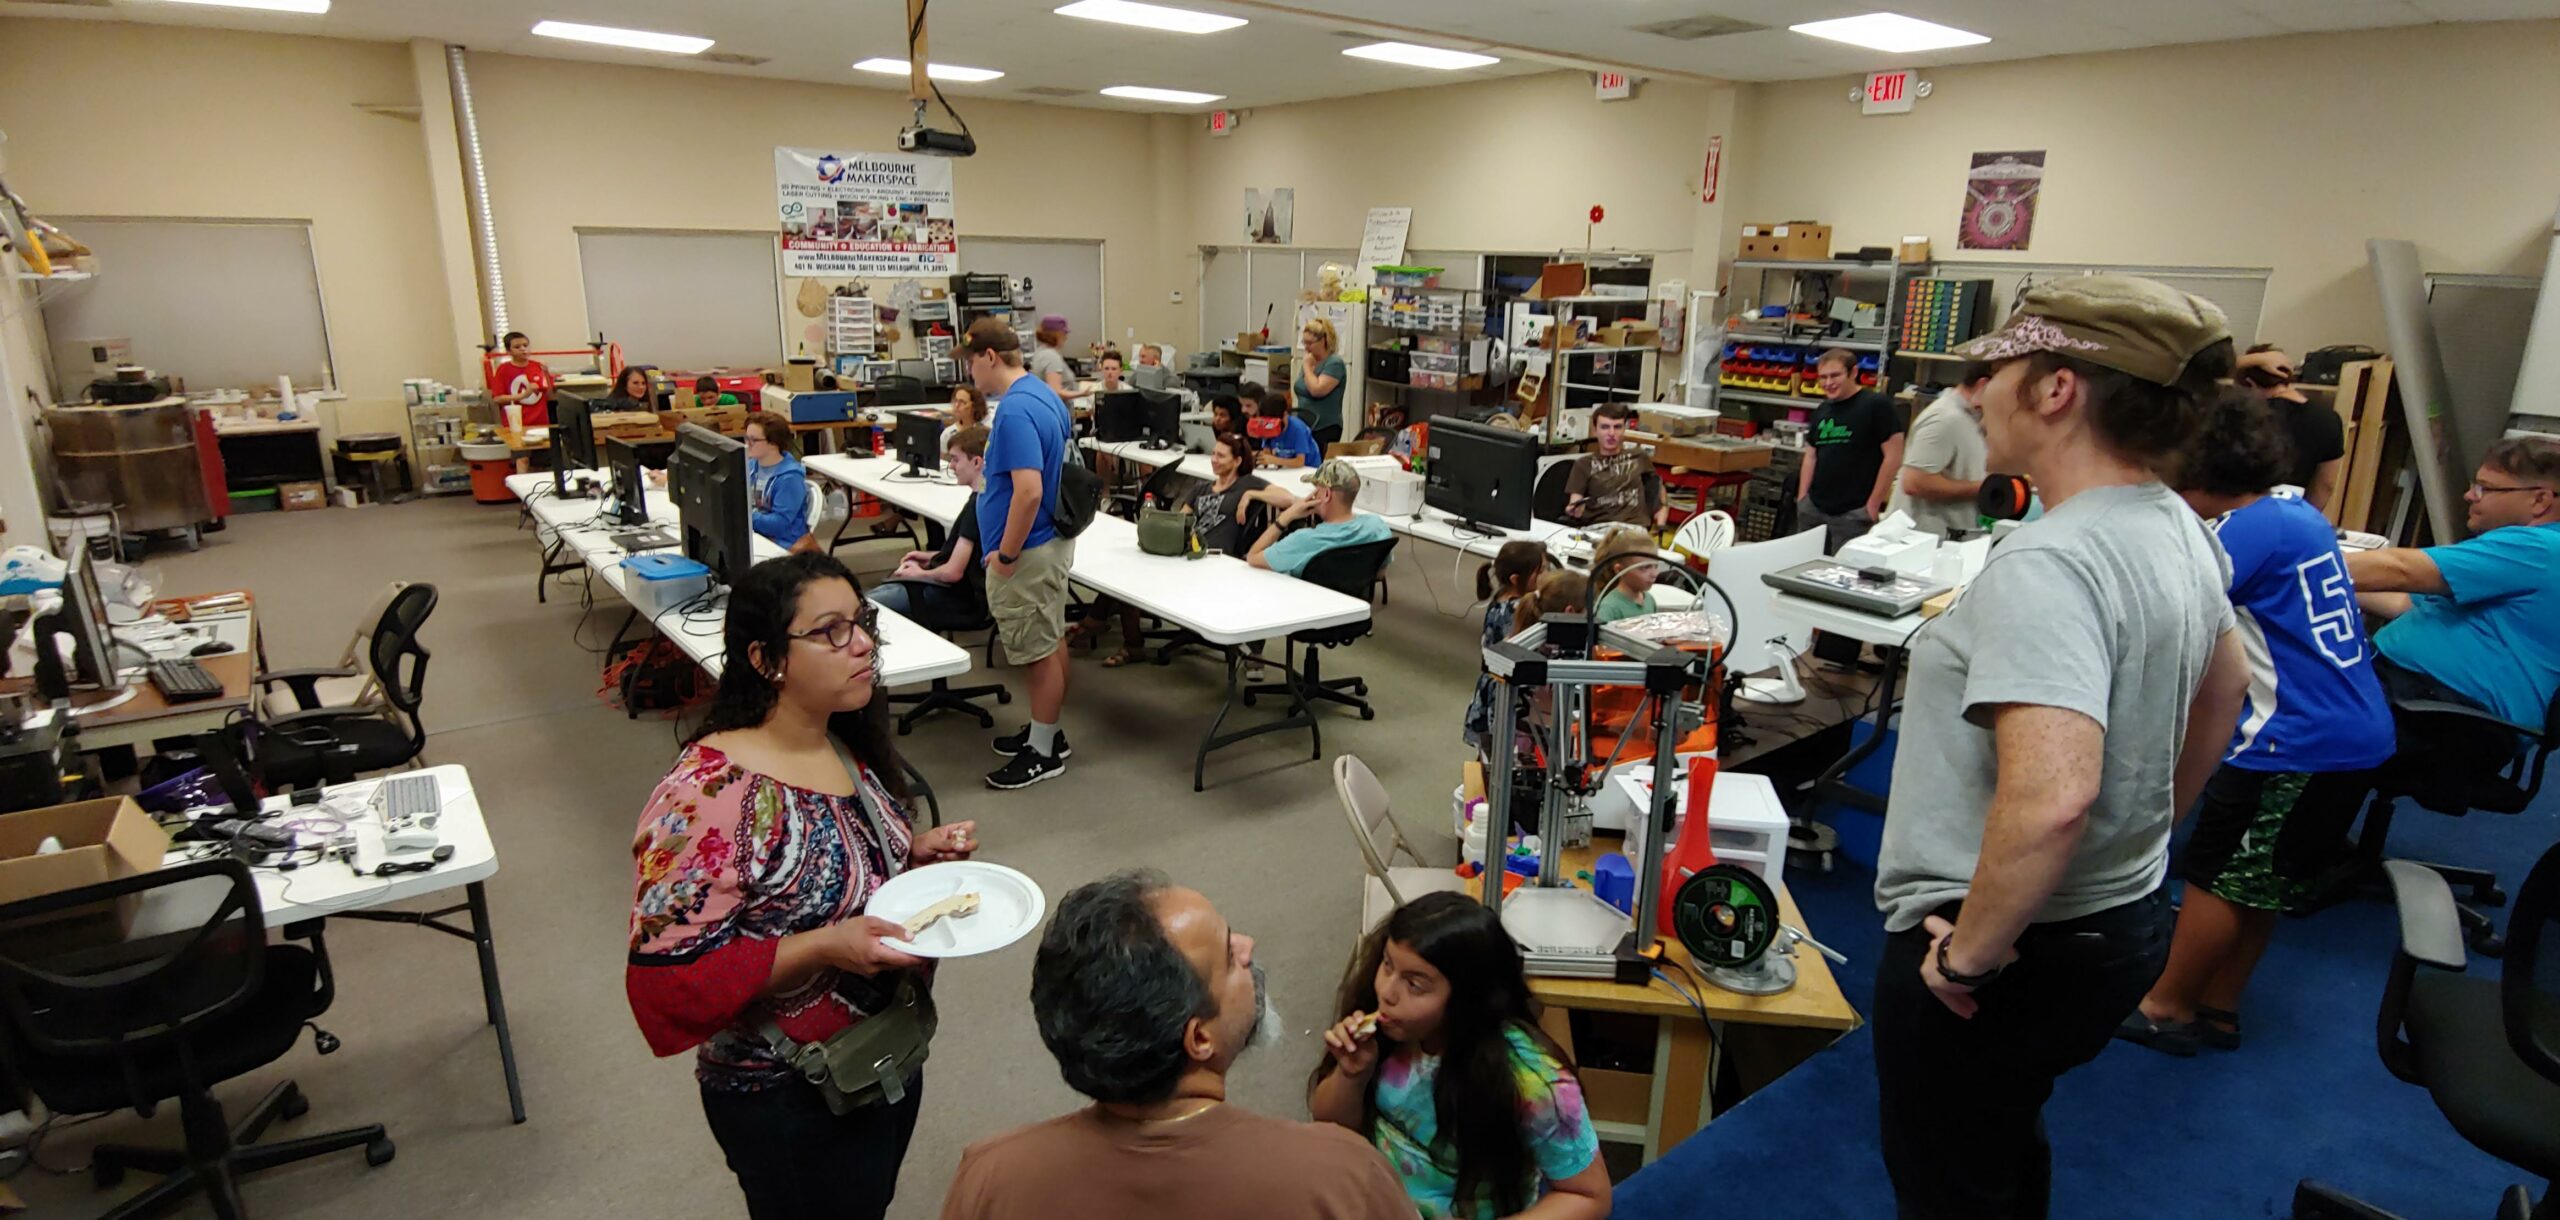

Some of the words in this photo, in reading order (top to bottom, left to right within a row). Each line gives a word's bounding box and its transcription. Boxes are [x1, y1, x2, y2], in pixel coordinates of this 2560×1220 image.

[1873, 73, 1906, 102] EXIT
[848, 161, 916, 174] MELBOURNE
[846, 173, 918, 186] MAKERSPACE
[790, 184, 821, 192] PRINTING
[804, 191, 833, 199] CUTTING
[788, 240, 839, 251] COMMUNITY
[849, 242, 893, 252] EDUCATION
[902, 242, 950, 253] FABRICATION
[816, 263, 846, 271] WICKHAM
